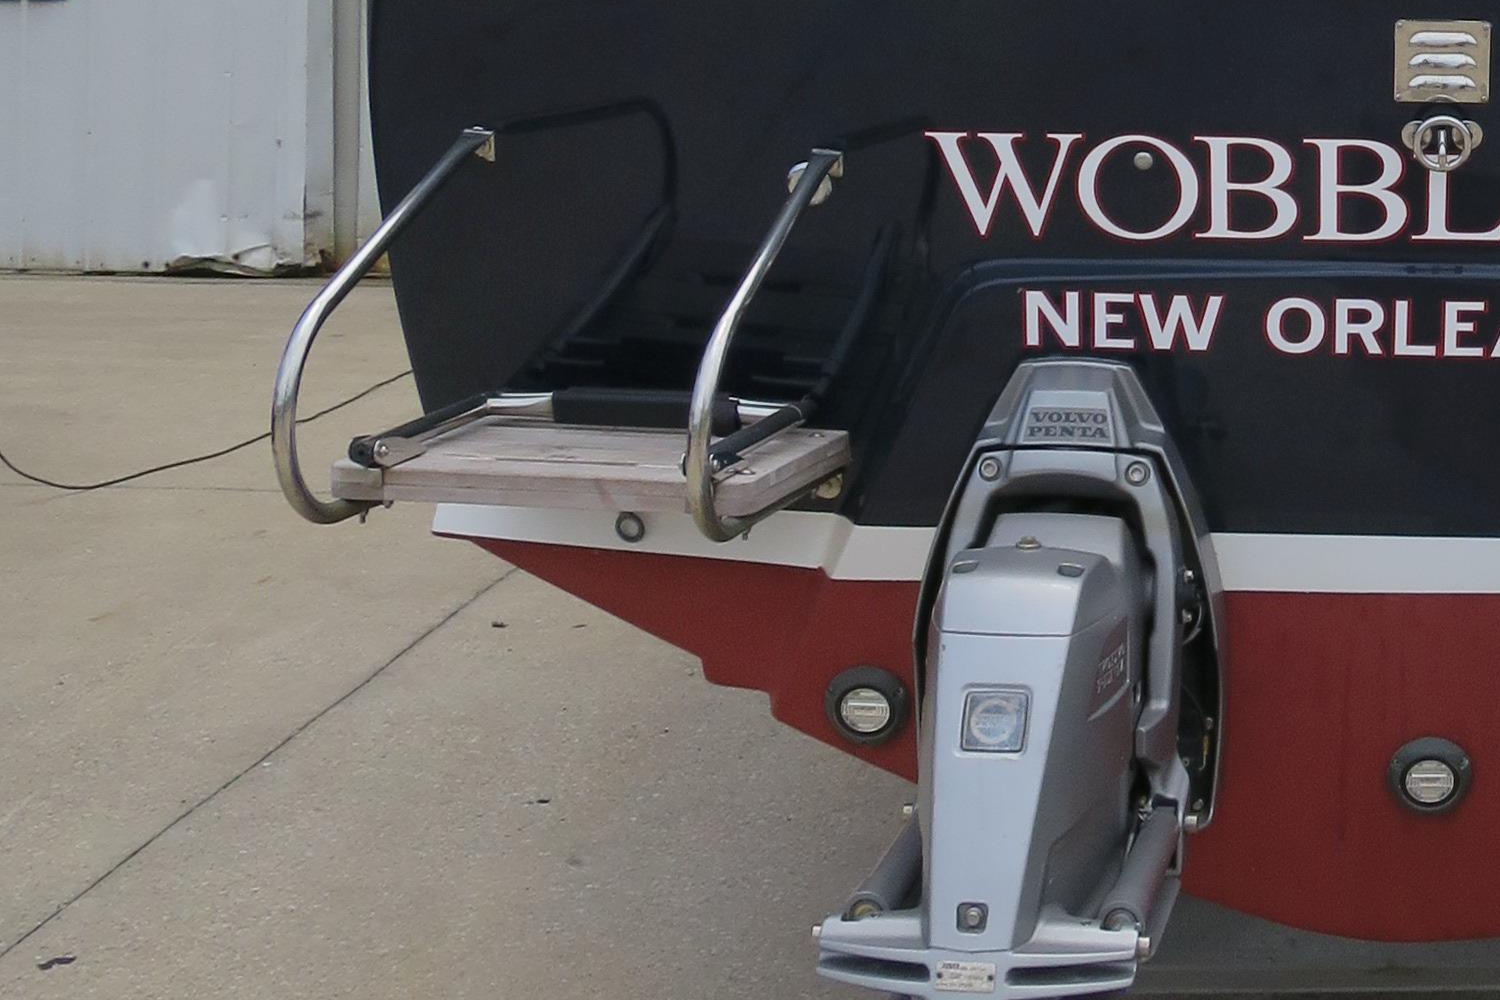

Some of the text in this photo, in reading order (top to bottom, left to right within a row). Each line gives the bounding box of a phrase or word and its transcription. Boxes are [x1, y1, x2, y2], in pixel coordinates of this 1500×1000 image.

[1022, 288, 1225, 352] NEW
[1030, 411, 1107, 424] VOLVO
[1027, 426, 1109, 438] PENTA
